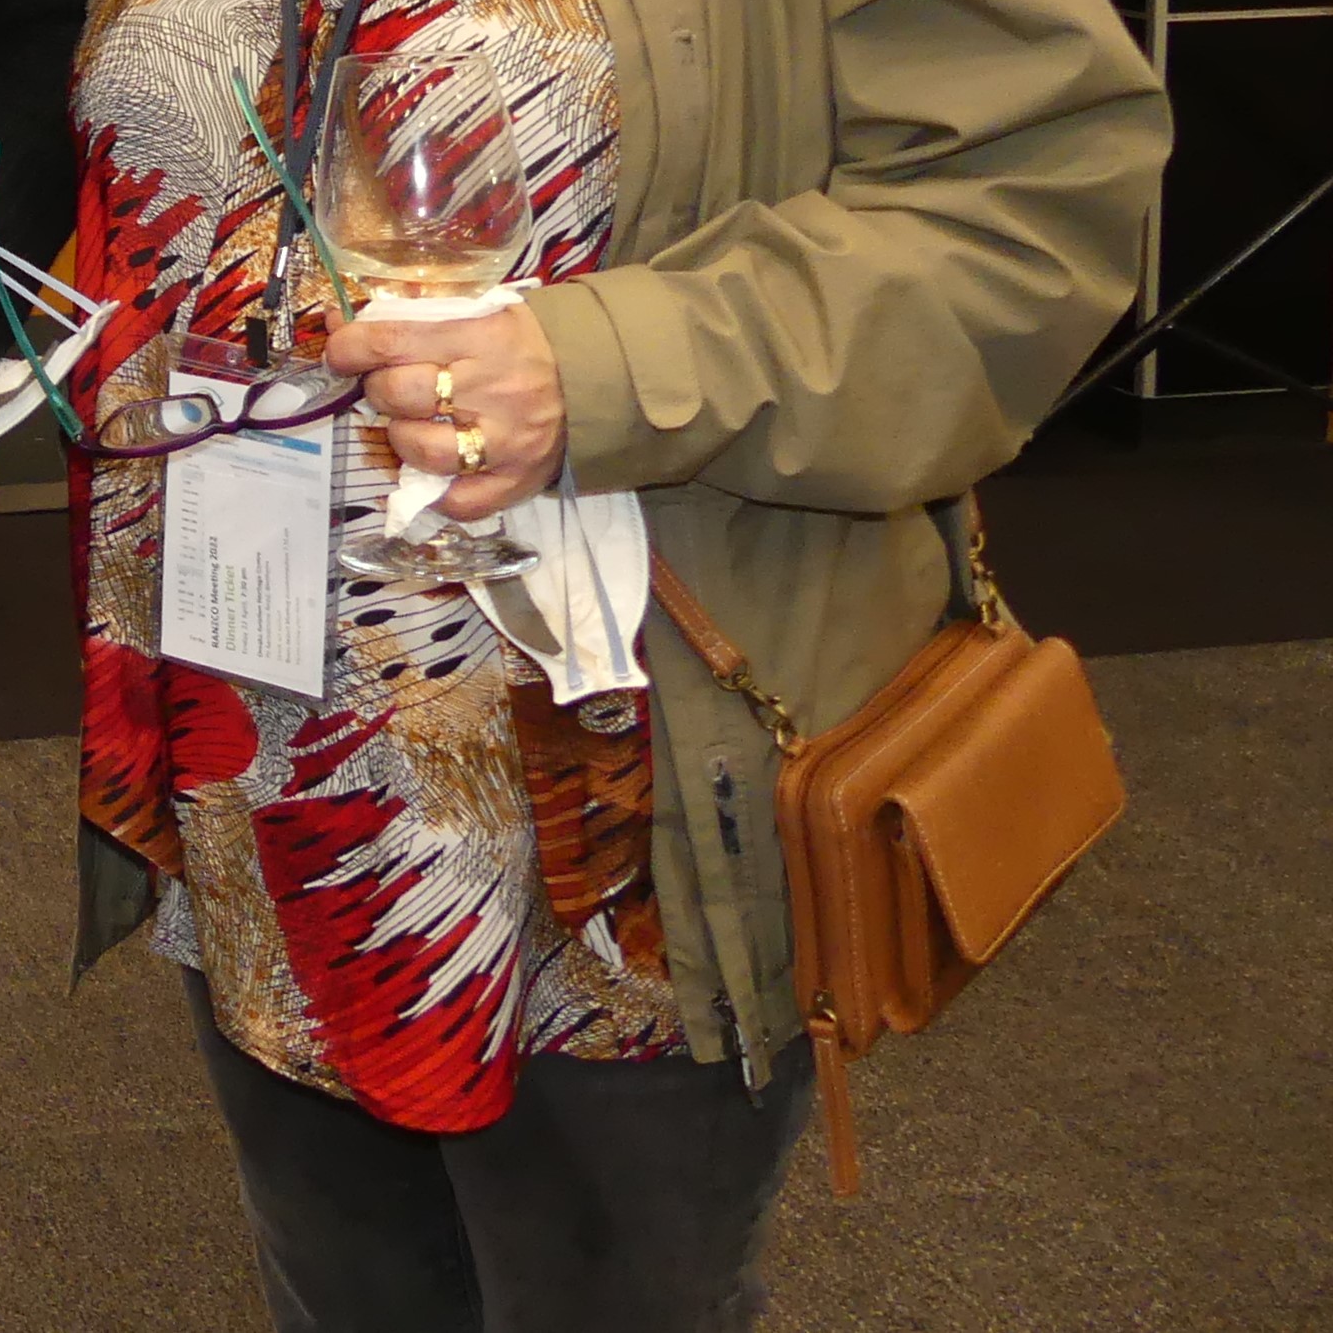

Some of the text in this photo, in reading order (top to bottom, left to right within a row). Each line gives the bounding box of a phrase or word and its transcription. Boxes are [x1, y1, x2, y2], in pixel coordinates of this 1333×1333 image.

[210, 563, 221, 605] Meeting
[224, 564, 236, 652] Dinner Ticket
